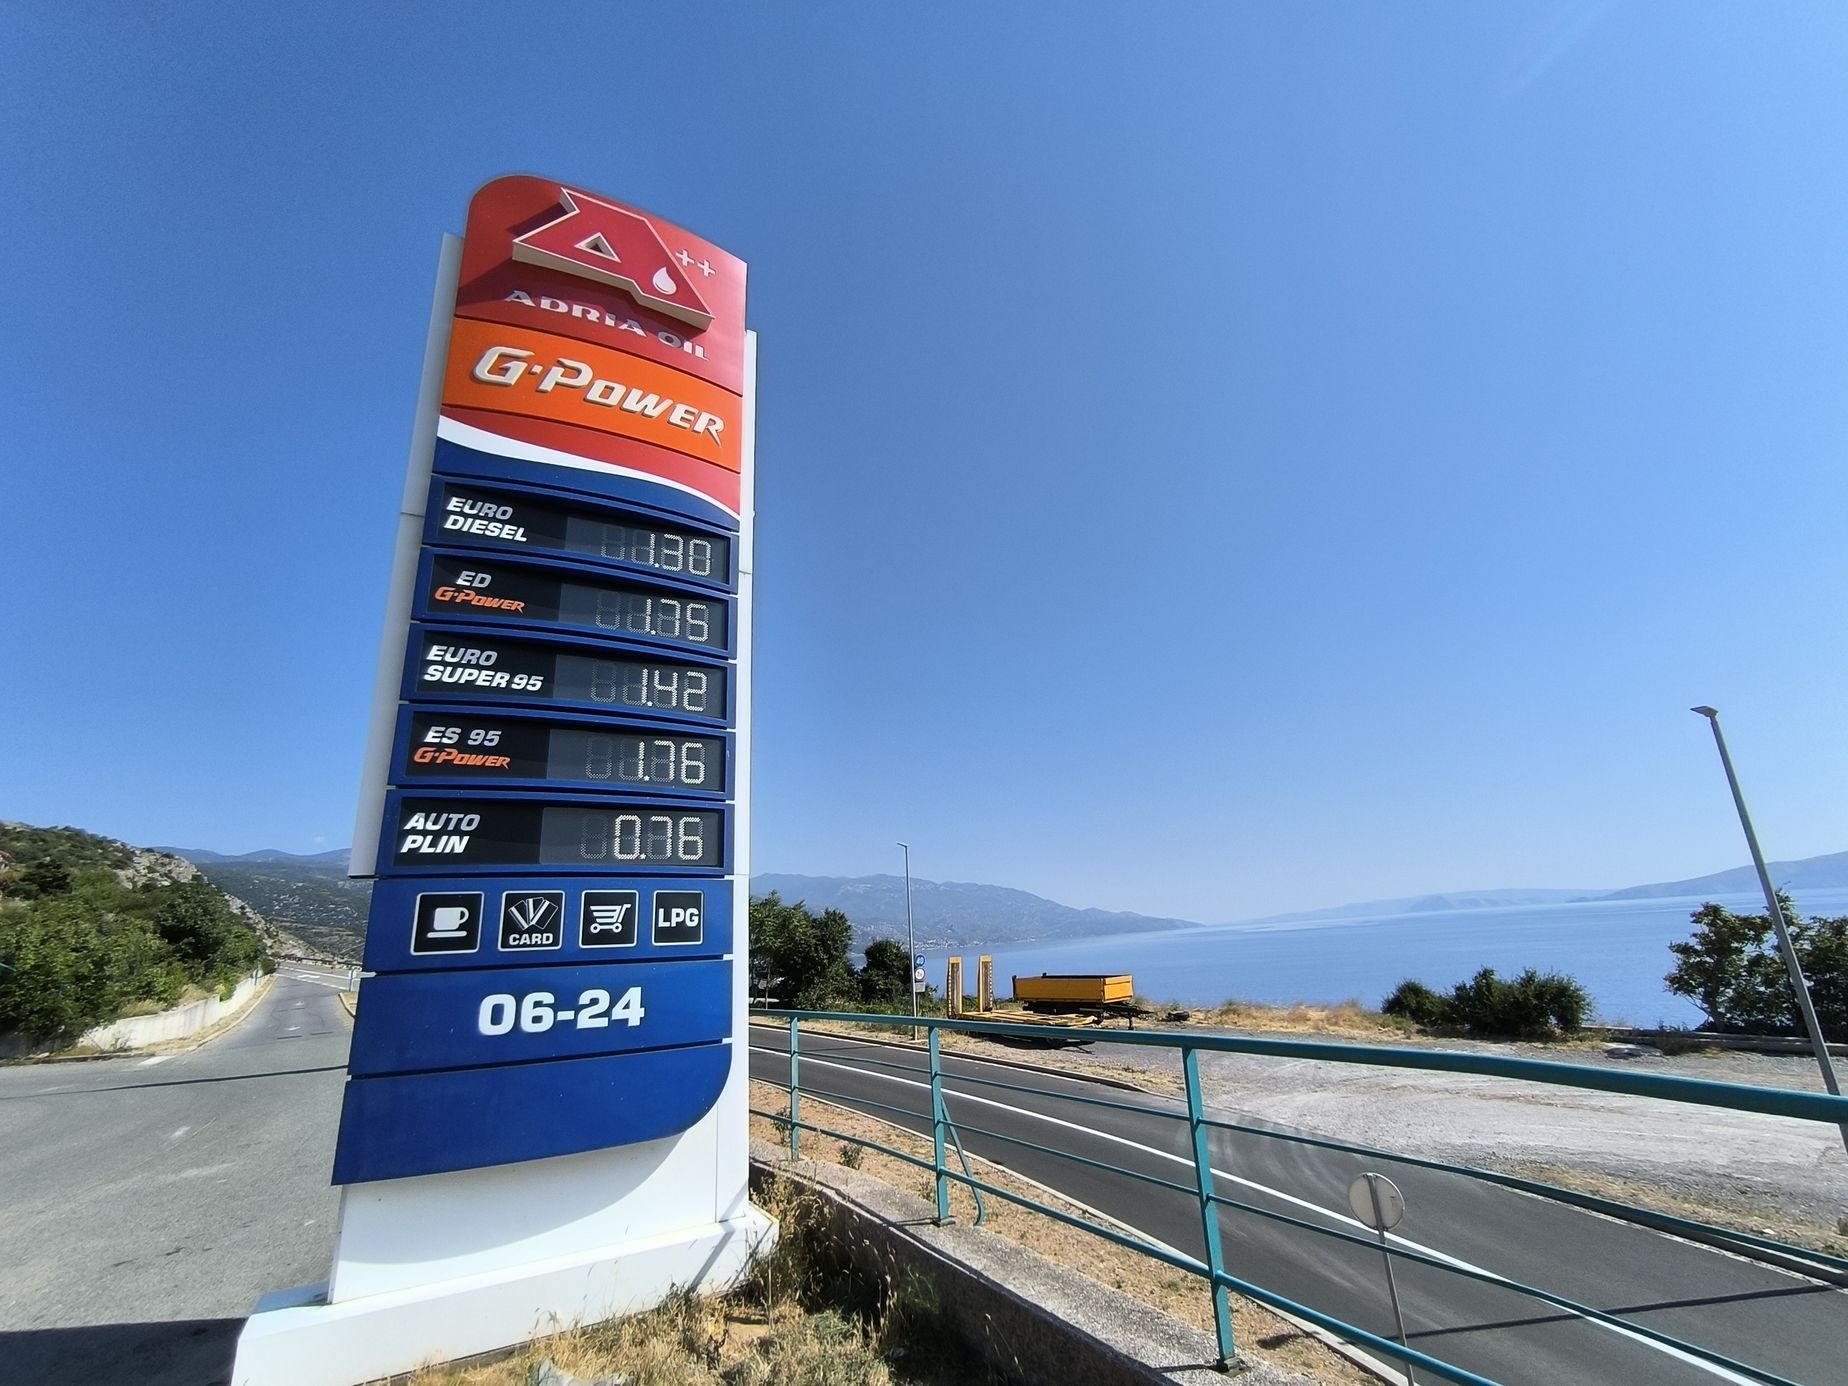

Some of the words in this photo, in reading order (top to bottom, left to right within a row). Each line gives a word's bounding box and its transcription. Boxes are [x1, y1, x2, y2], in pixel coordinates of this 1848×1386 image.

[504, 290, 648, 338] ADRIA
[658, 331, 710, 361] OIL
[446, 496, 514, 521] EURO
[443, 515, 528, 542] DIESEL
[650, 533, 712, 577] 1.30
[456, 571, 493, 588] ED
[645, 598, 710, 642] 1.75
[425, 645, 499, 667] EURO
[423, 665, 509, 690] SUPER
[511, 675, 545, 692] 95
[640, 668, 708, 712] 1.42
[423, 726, 463, 744] ES
[467, 730, 503, 747] 95
[637, 740, 706, 784] 1.76
[403, 812, 482, 832] AUTO
[400, 835, 471, 854] PLIN
[613, 814, 704, 860] 0.76
[657, 908, 701, 928] LPG
[508, 932, 555, 946] CARD
[478, 986, 646, 1036] 06-24
